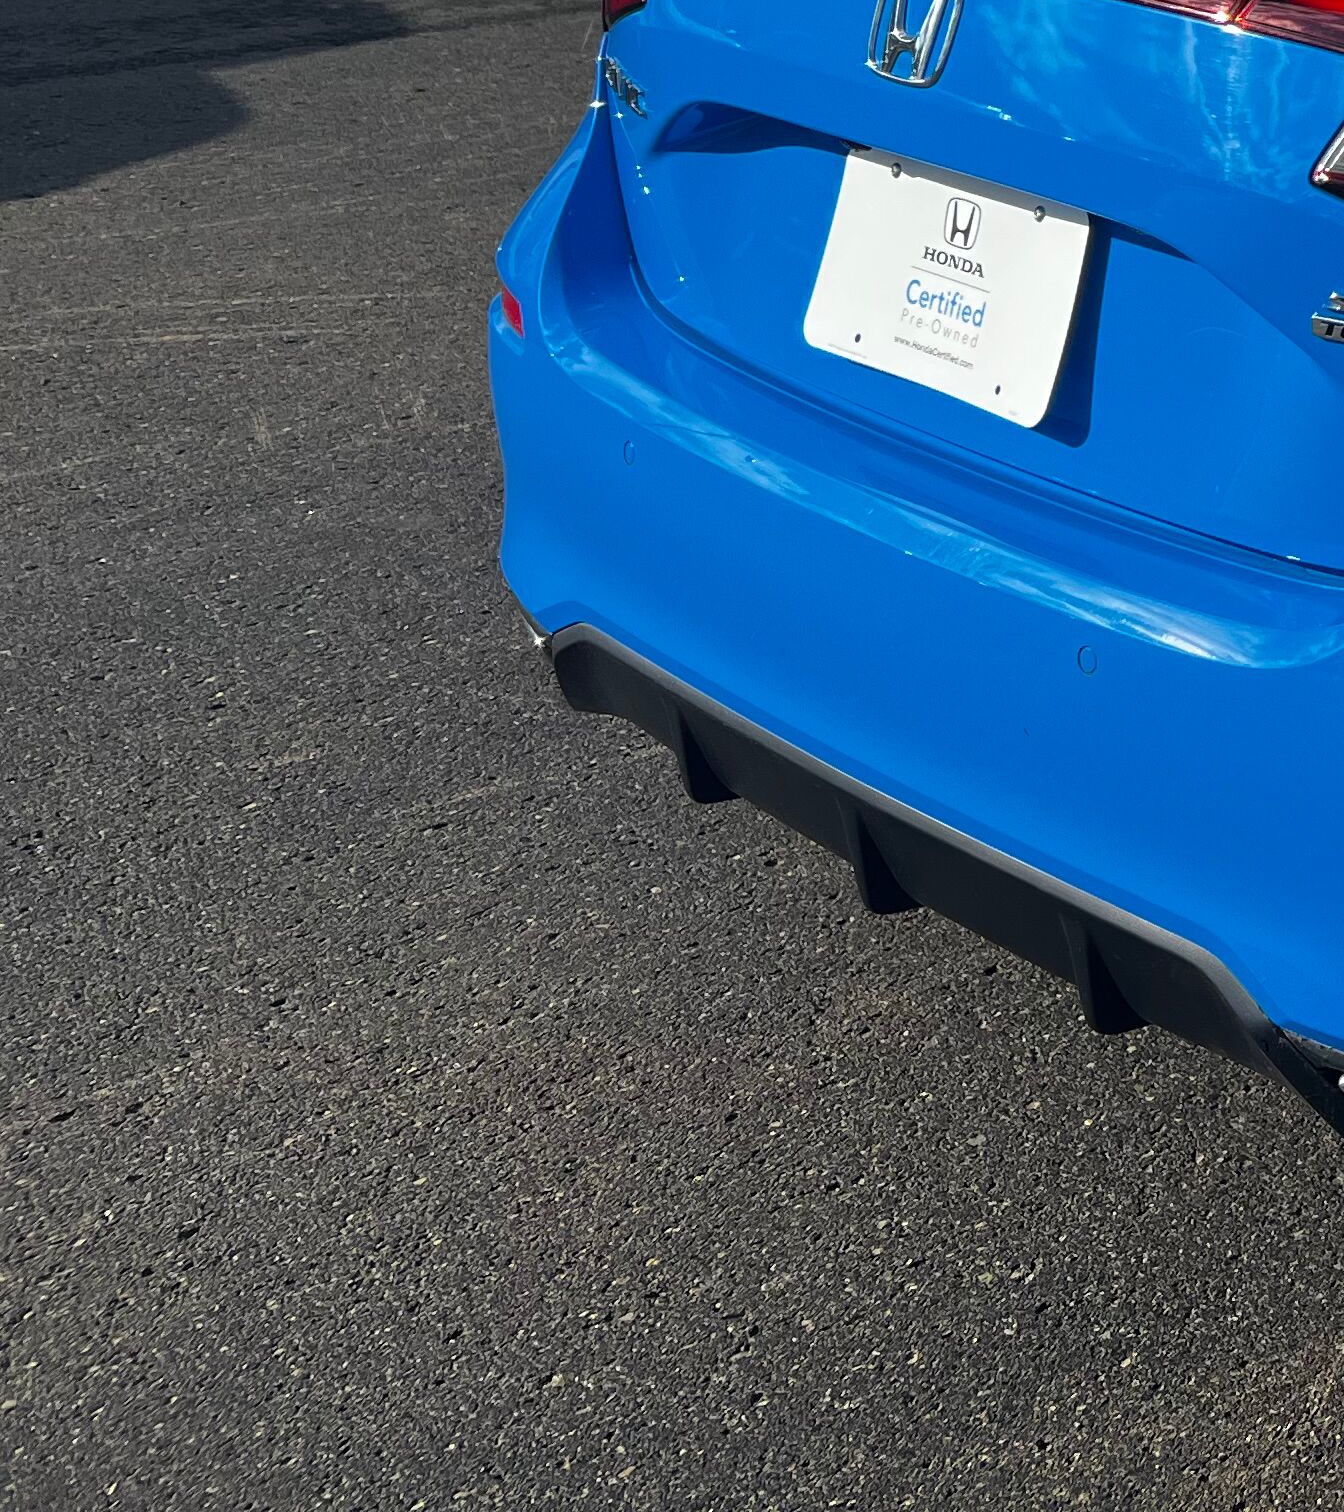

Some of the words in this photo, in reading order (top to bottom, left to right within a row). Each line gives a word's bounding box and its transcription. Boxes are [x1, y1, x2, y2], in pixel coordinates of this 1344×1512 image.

[922, 245, 984, 278] HONDA
[906, 279, 987, 327] Certified
[900, 308, 980, 348] Pre-Owned
